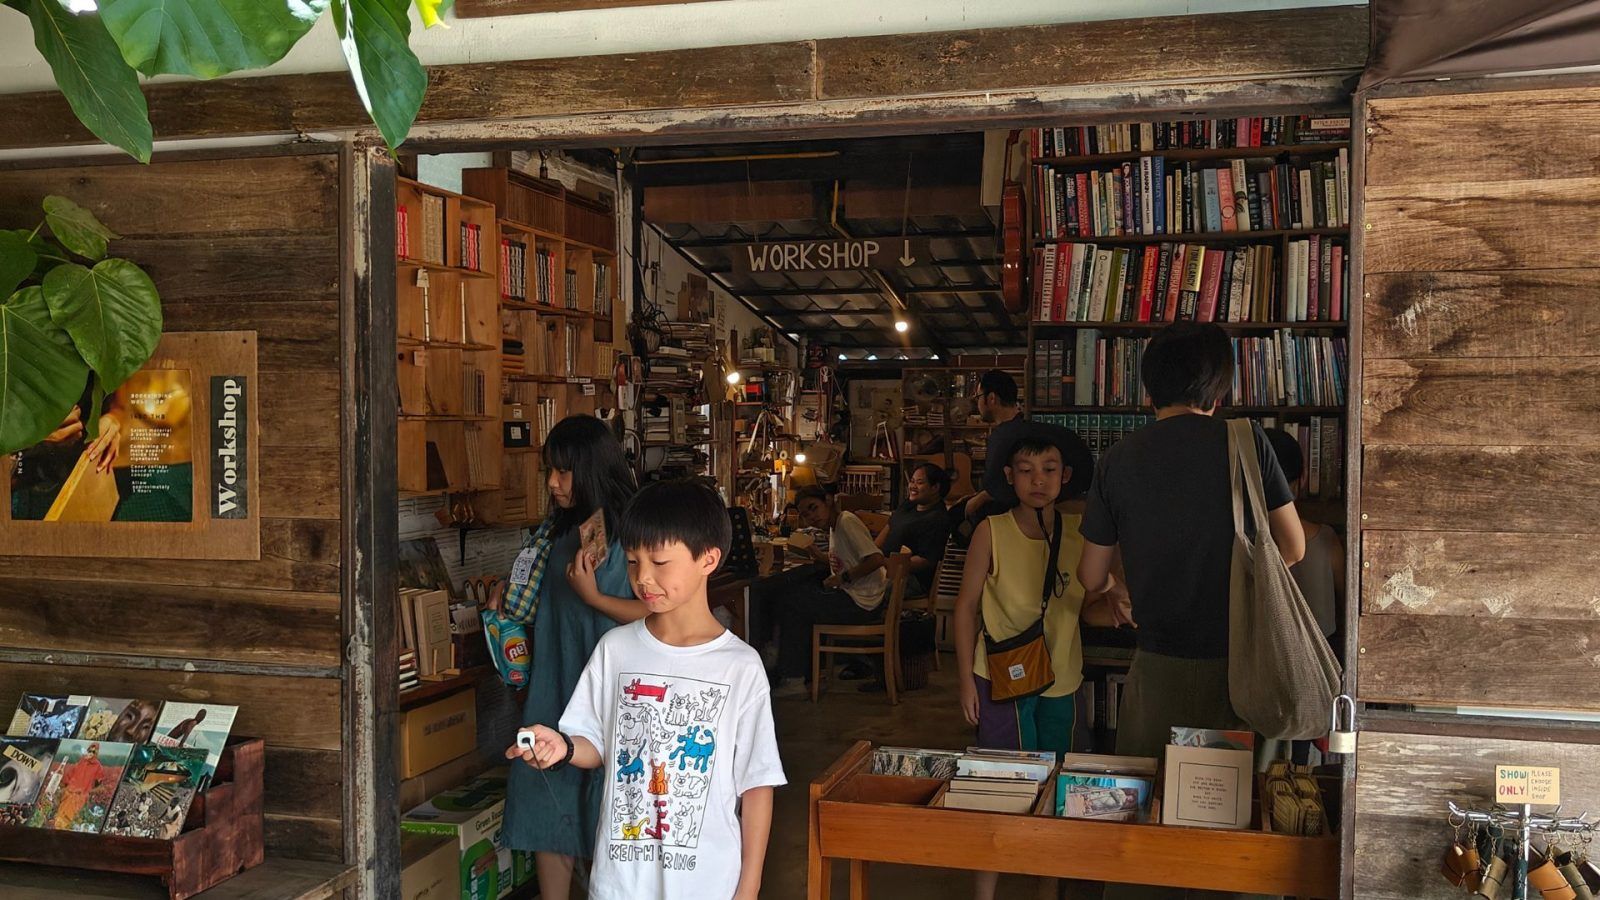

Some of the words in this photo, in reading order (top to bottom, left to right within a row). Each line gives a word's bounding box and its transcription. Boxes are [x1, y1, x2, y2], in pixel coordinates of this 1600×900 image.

[748, 240, 880, 272] WORKSHOP
[1160, 251, 1169, 267] David
[1190, 249, 1199, 262] TOM
[1157, 267, 1167, 291] Baldacci
[1187, 263, 1198, 287] CLANCY
[218, 379, 243, 516] Workshop
[10, 750, 37, 769] DOWN
[1500, 769, 1527, 779] SHOW
[1499, 785, 1525, 795] ONLY
[609, 843, 655, 862] KEITH
[657, 845, 697, 871] HRING
